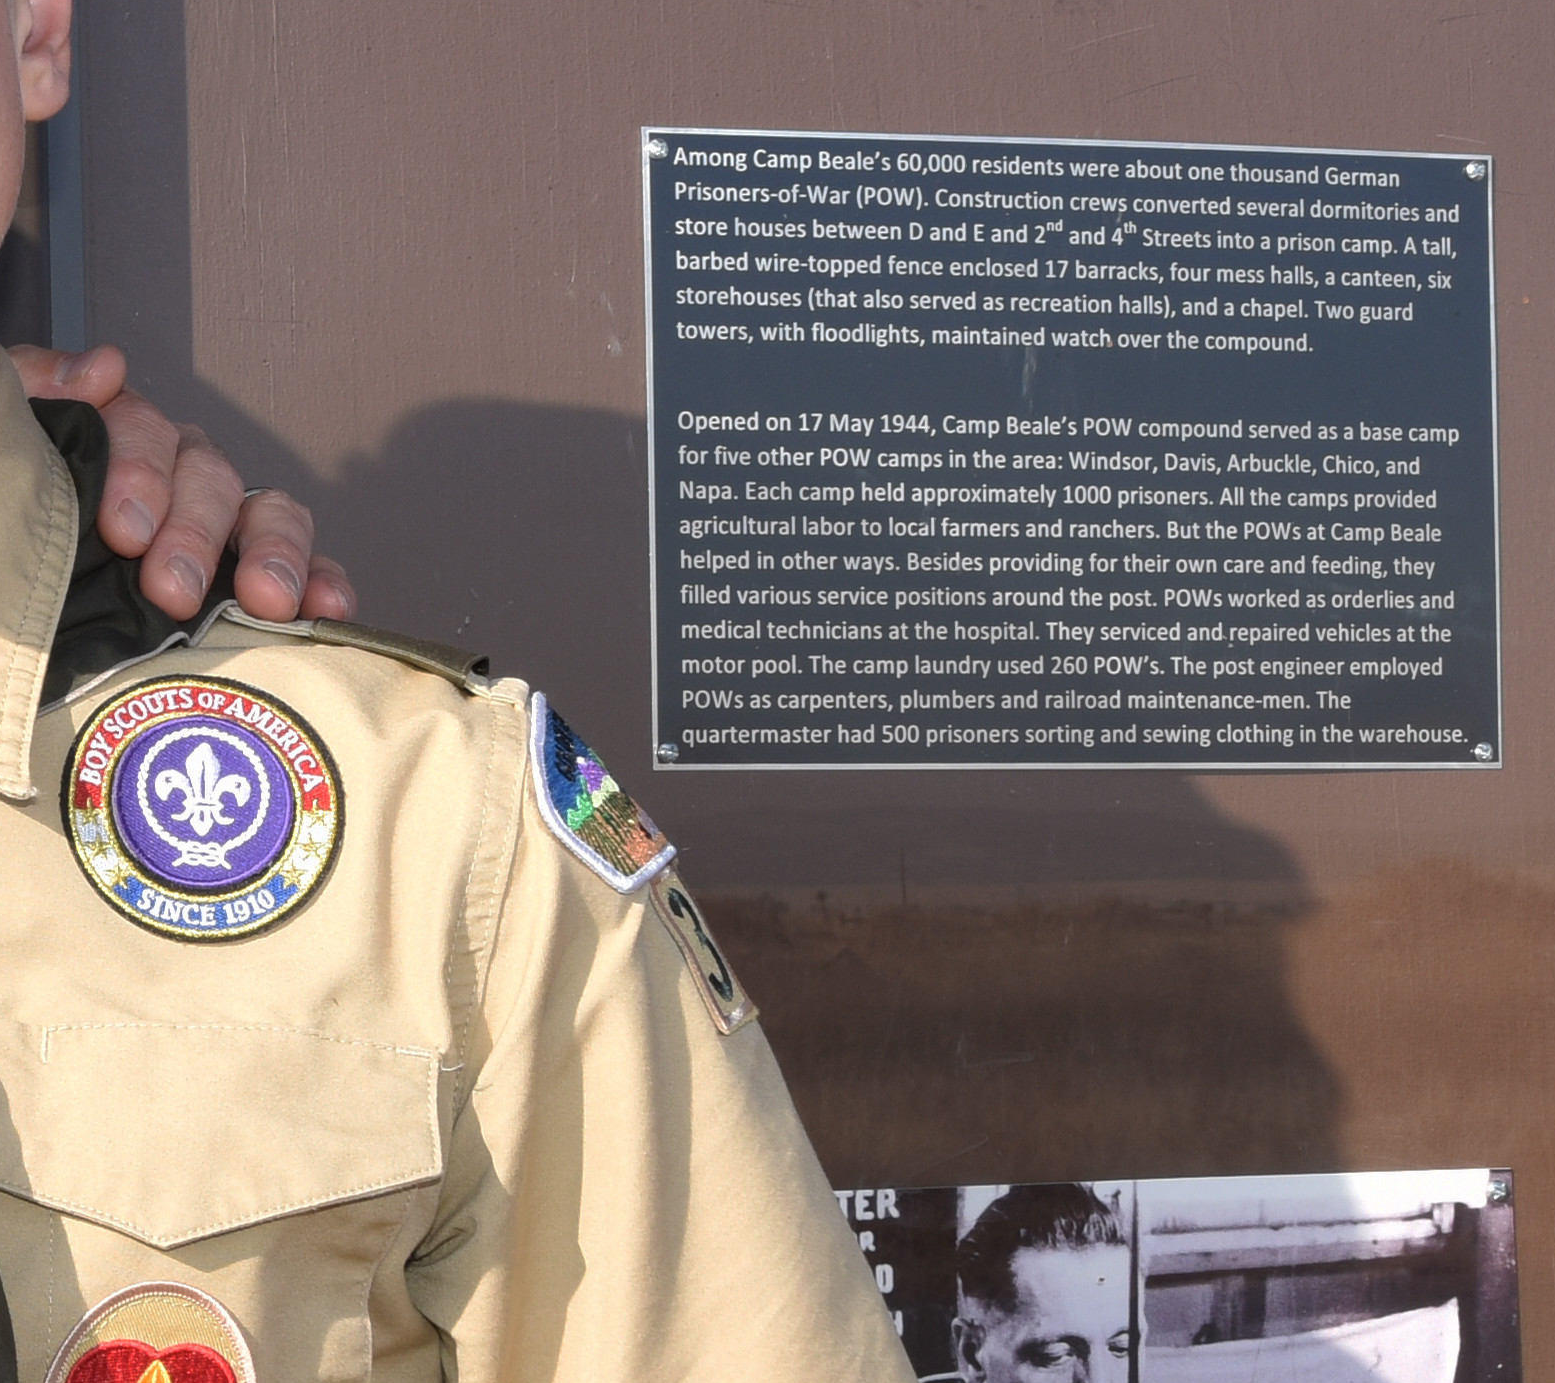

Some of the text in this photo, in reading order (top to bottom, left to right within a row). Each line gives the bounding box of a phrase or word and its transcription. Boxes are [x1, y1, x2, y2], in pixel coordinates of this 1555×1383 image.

[672, 146, 749, 173] Among
[752, 148, 813, 175] Camp
[895, 152, 968, 177] 60,000
[971, 155, 1065, 177] residents
[1068, 161, 1121, 179] were
[1124, 158, 1184, 181] about
[1186, 165, 1225, 182] one
[1228, 162, 1320, 185] thousand
[1324, 166, 1401, 188] German
[674, 180, 1460, 224] Prisoners-of-War (POW). Construction crews converted several dormitories and
[675, 249, 1453, 293] barbed wire-topped fence enclosed 17 barracks, four mess halls, a canteen, six
[675, 320, 1314, 356] towers, with floodlights, maintained watch over the compound.
[677, 443, 1421, 479] for five other POW camps in the area: Windsor, Davis, Arbuckle, Chico, and
[678, 479, 1437, 513] Napa. Each camp held approximately 1000 prisoners. All the camps provided
[79, 688, 325, 792] BOY SCOUTS OF AMERICA
[681, 722, 1469, 749] quartermaster had 500 prisoners sorting and sewing clothing in the warehouse.
[136, 888, 276, 927] SINCE 1910
[833, 1188, 901, 1221] TER
